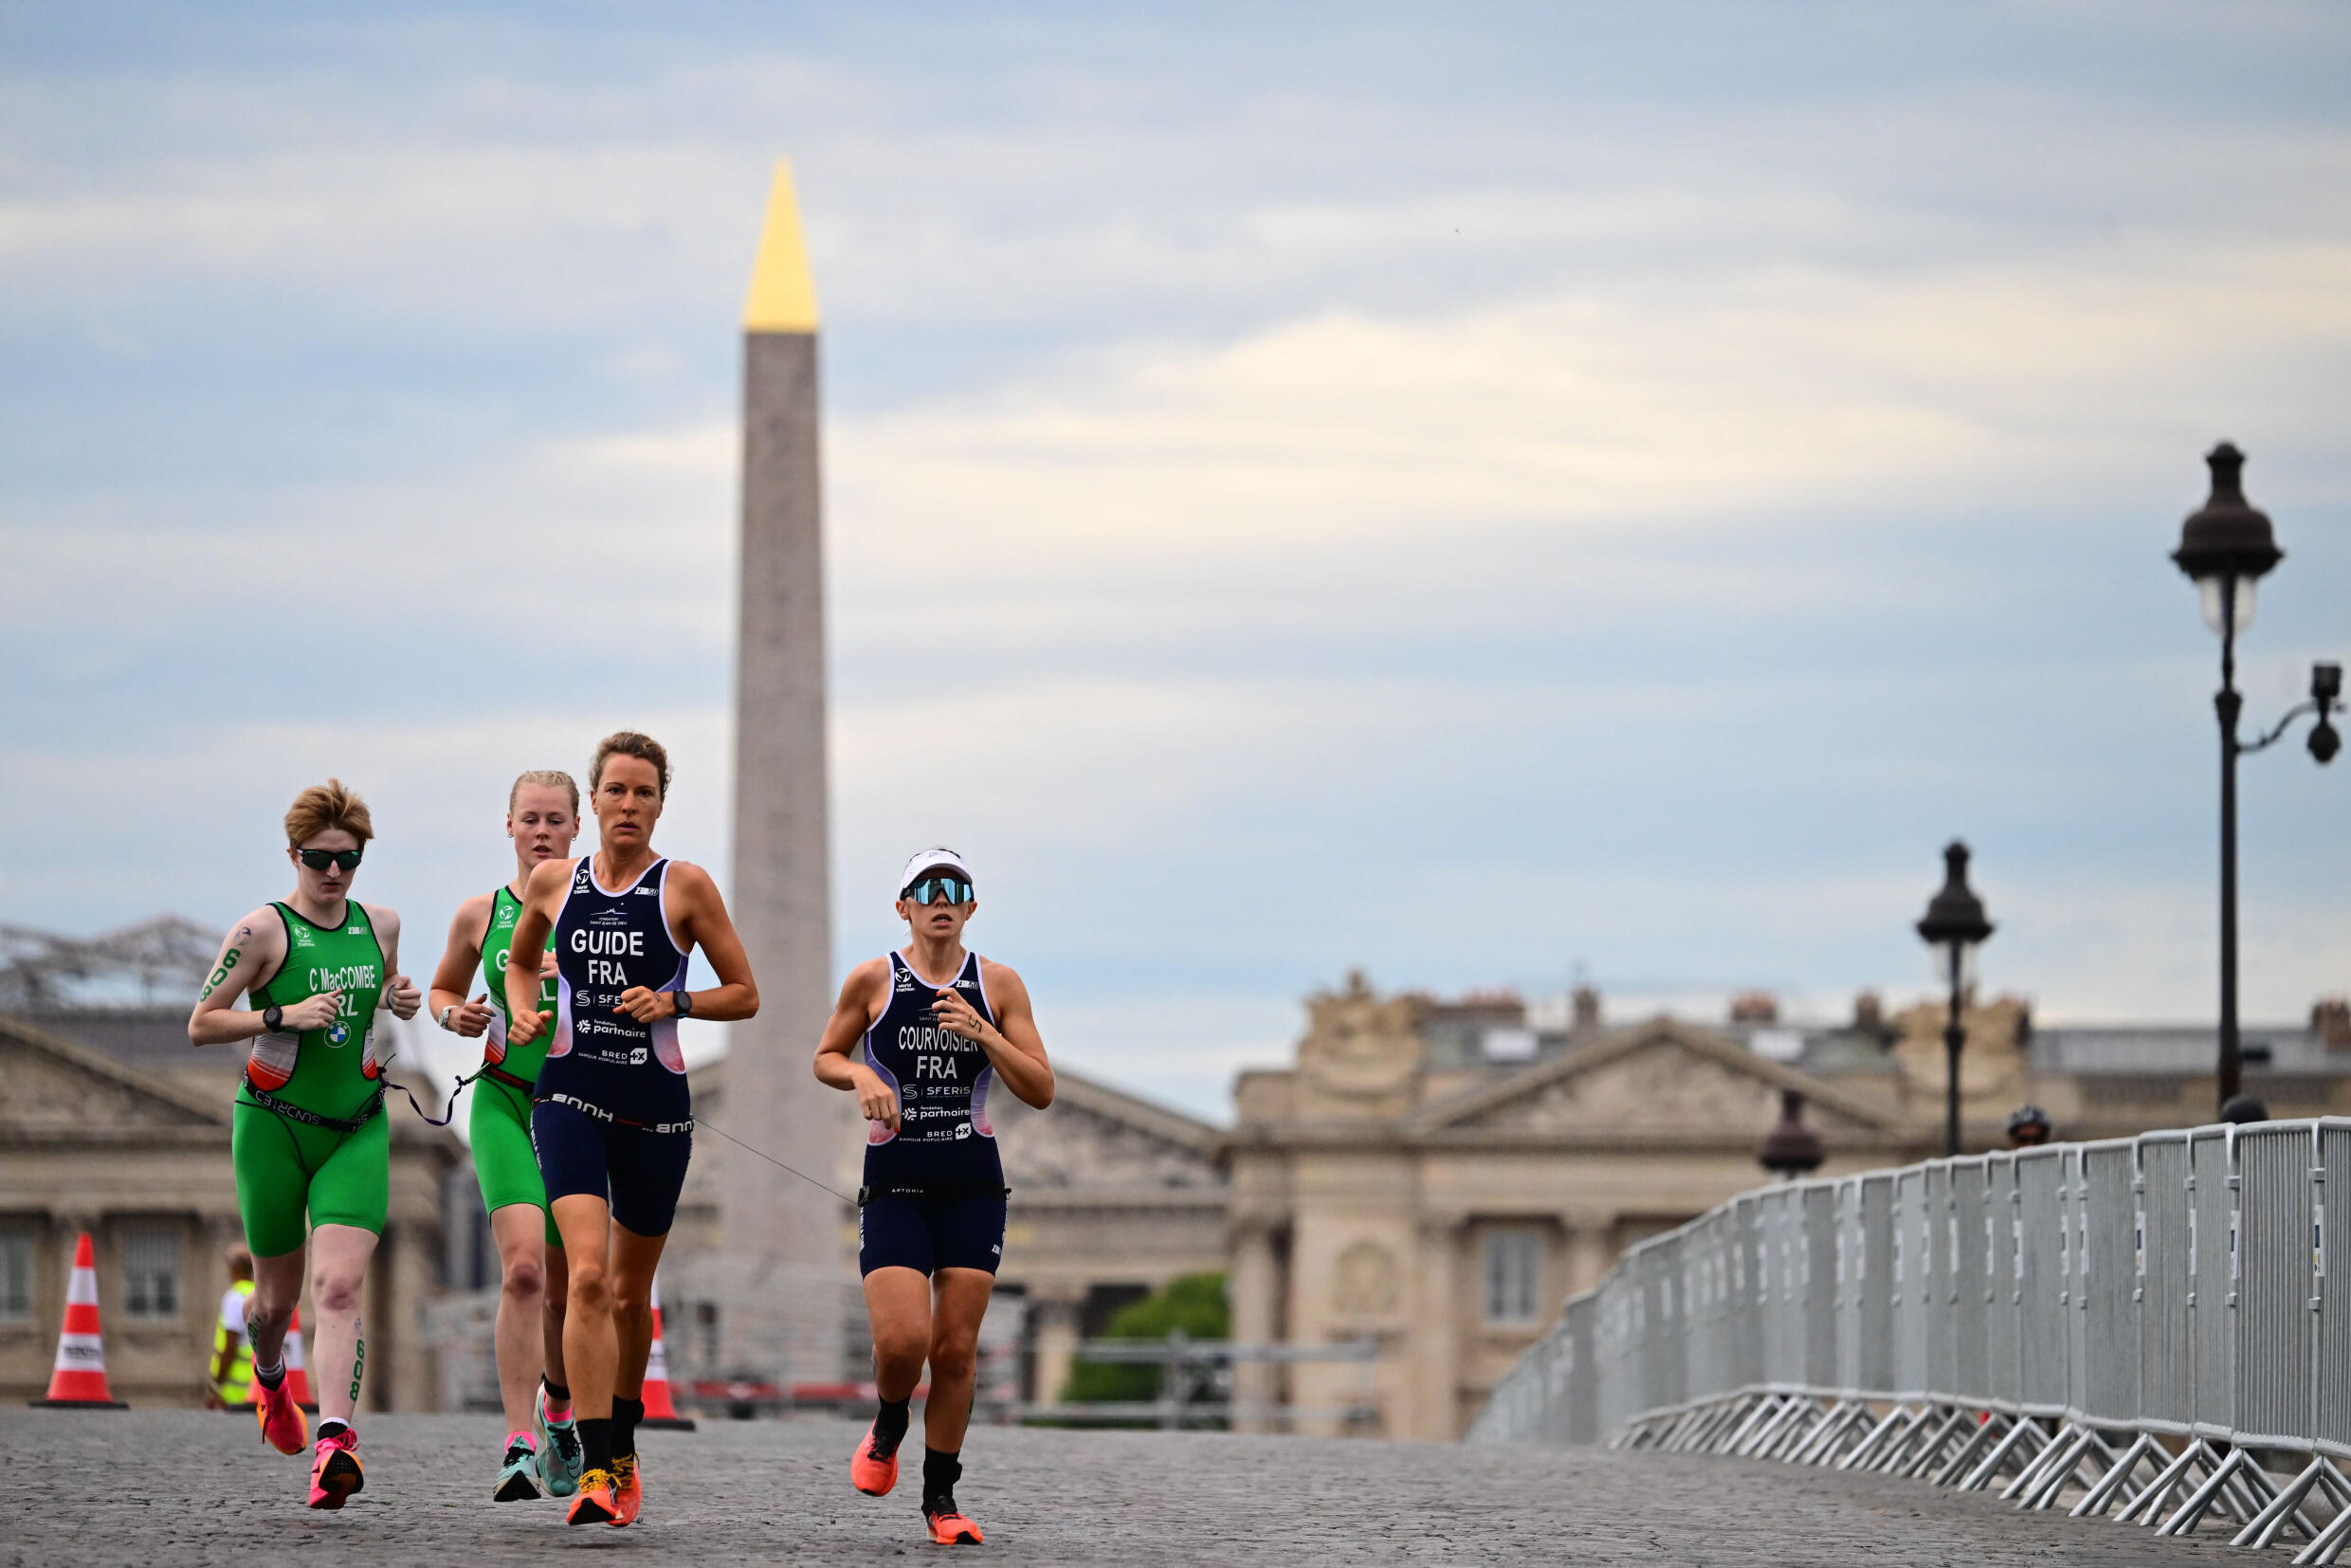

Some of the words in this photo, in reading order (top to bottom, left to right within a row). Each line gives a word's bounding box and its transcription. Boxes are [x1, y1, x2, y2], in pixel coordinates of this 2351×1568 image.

[571, 929, 645, 957] GUIDE
[200, 948, 241, 1002] 608
[309, 968, 318, 993] C
[319, 965, 376, 991] MacCOMBE
[588, 959, 628, 985] FRA
[336, 994, 359, 1017] RL
[598, 994, 622, 1005] SFE
[593, 1025, 647, 1038] partnaire
[602, 1049, 628, 1060] BRED
[916, 1055, 957, 1079] FRA
[255, 1090, 320, 1125] SUNDRIED
[552, 1093, 613, 1122] HUUB
[920, 1107, 971, 1121] partnaire
[656, 1120, 694, 1134] UUB
[350, 1339, 365, 1402] 608
